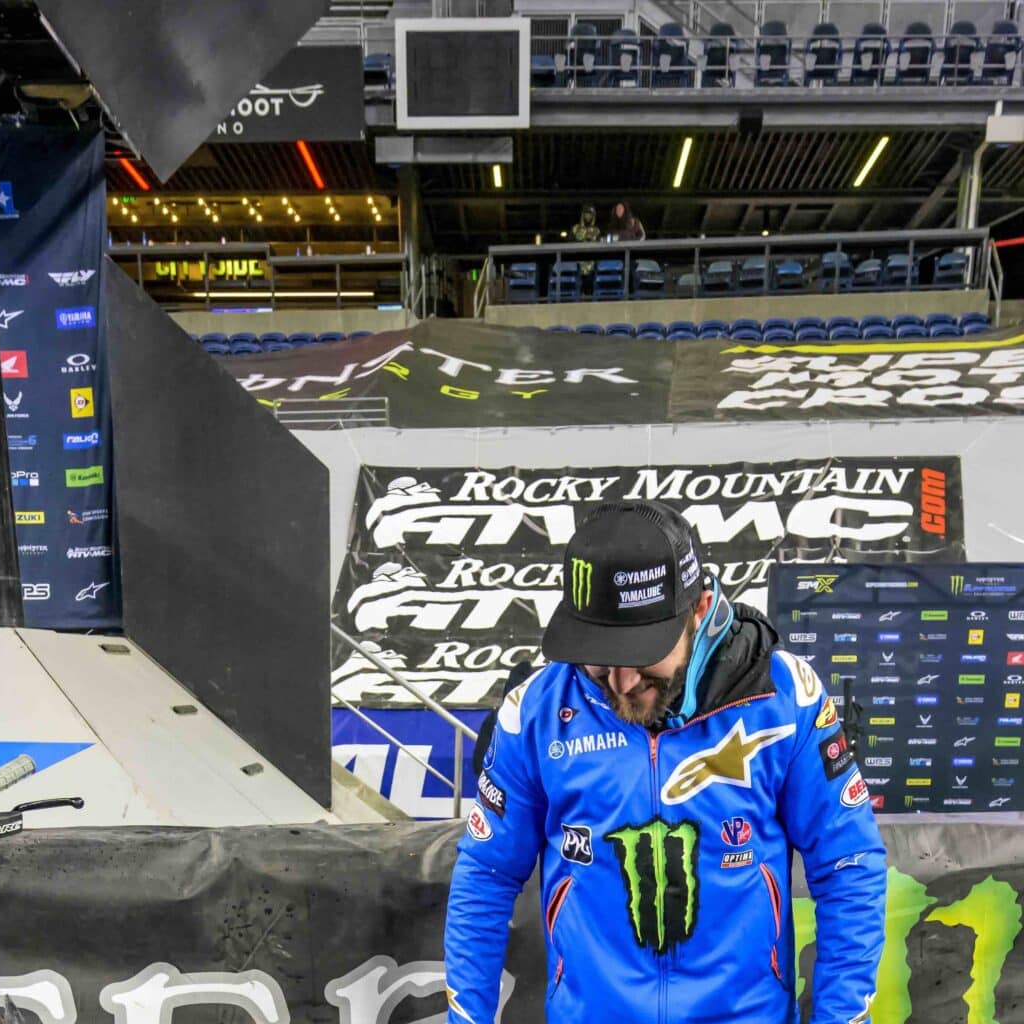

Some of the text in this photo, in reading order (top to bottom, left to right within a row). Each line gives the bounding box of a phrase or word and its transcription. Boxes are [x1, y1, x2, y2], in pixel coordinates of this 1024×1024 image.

[456, 466, 914, 502] ROCKY MOUNTAIN
[628, 564, 667, 584] YAMAHA
[619, 583, 663, 603] YAMALUBE
[565, 731, 629, 756] YAMAHA
